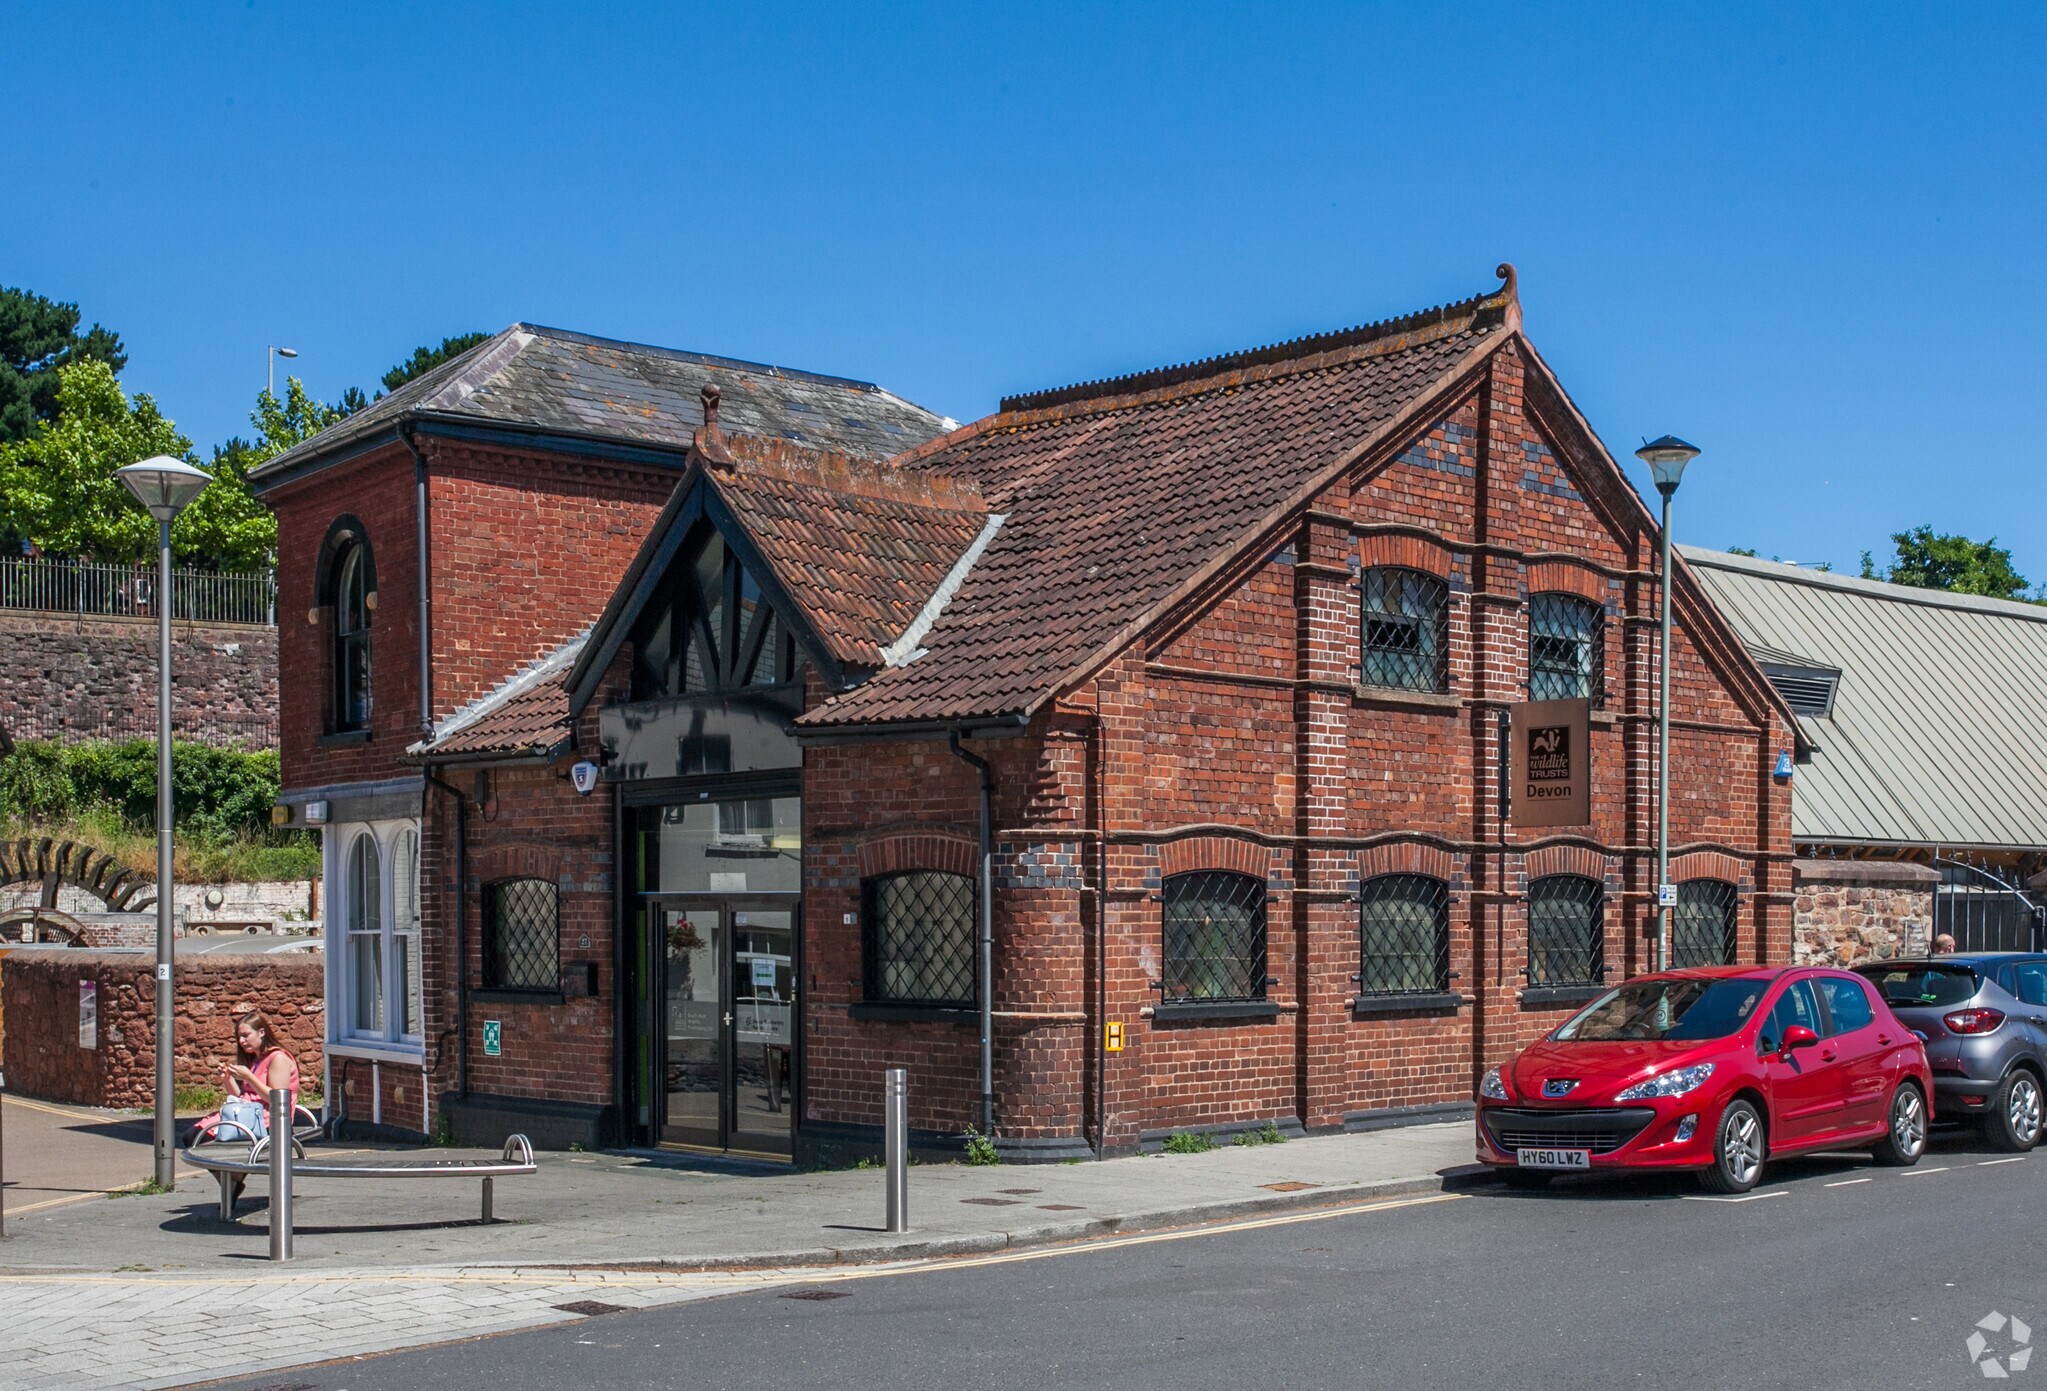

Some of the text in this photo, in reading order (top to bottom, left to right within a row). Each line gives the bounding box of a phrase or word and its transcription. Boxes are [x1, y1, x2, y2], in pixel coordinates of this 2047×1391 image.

[1530, 753, 1568, 769] wildlife
[1530, 769, 1568, 778] TRUSTS
[1527, 784, 1571, 798] Devon
[1522, 1150, 1583, 1165] HY60 LWZ
